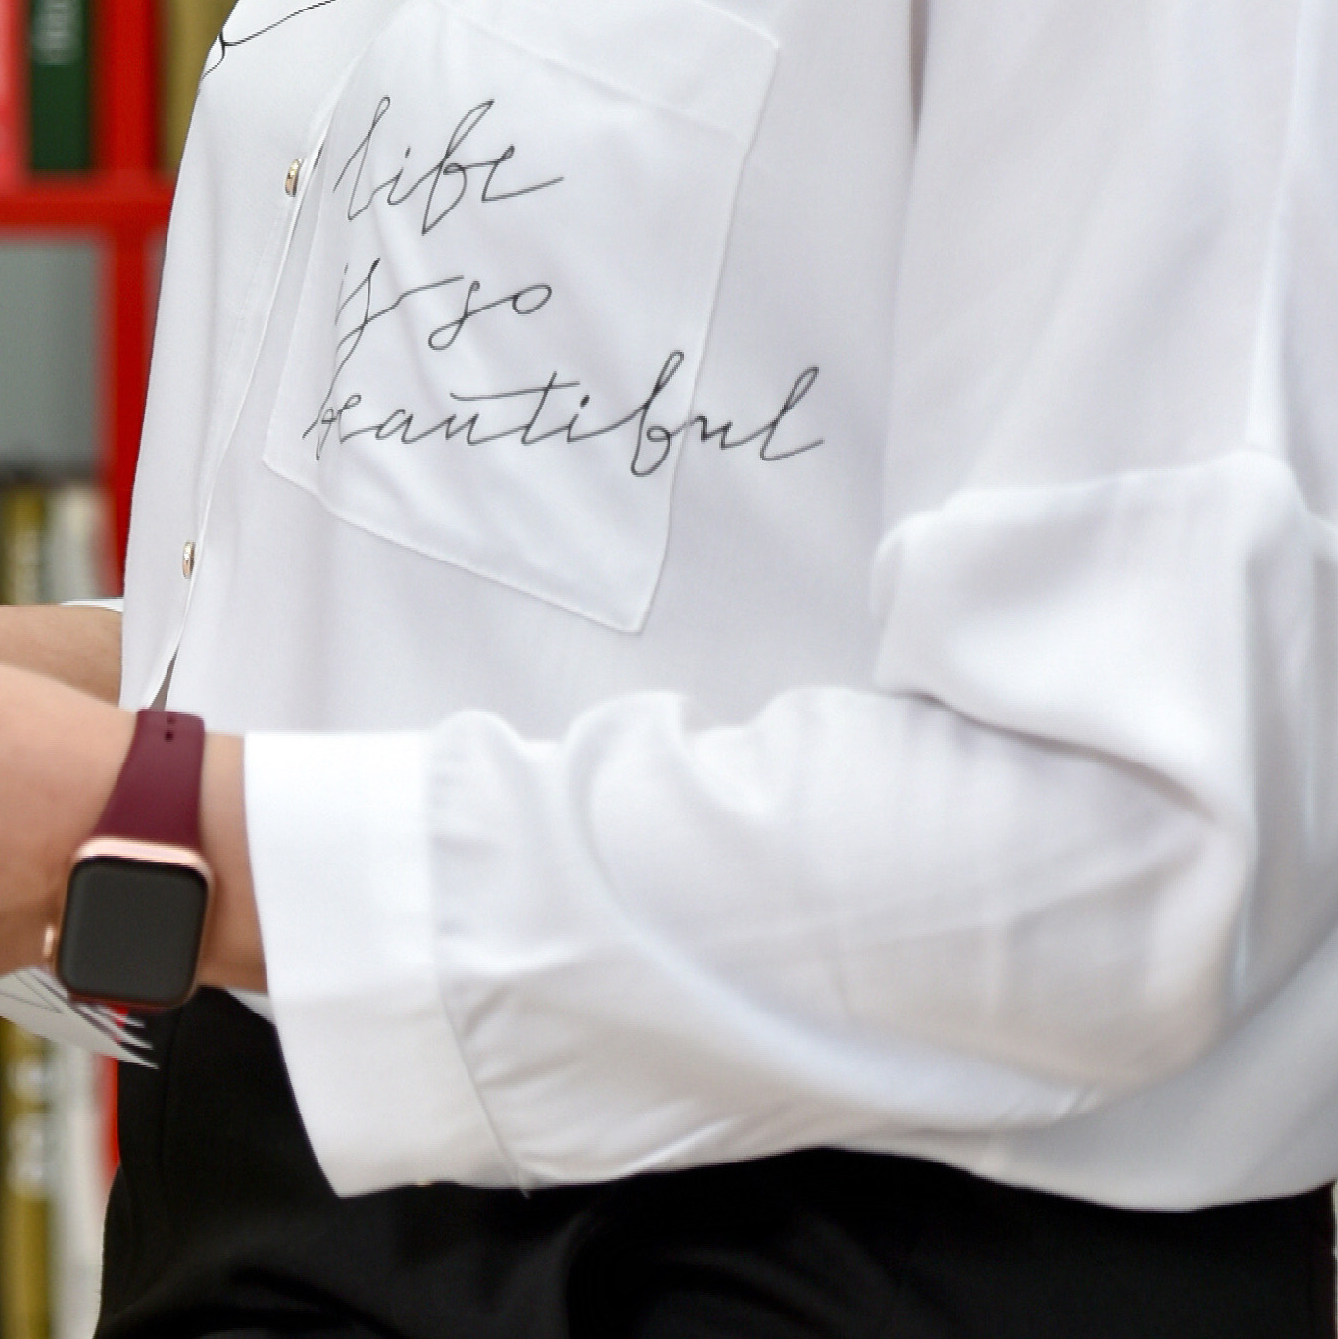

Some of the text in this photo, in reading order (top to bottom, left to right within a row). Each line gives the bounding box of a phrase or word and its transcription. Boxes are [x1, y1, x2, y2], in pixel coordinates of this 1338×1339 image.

[333, 95, 565, 237] life
[428, 280, 553, 351] so
[302, 343, 824, 478] beautiful
